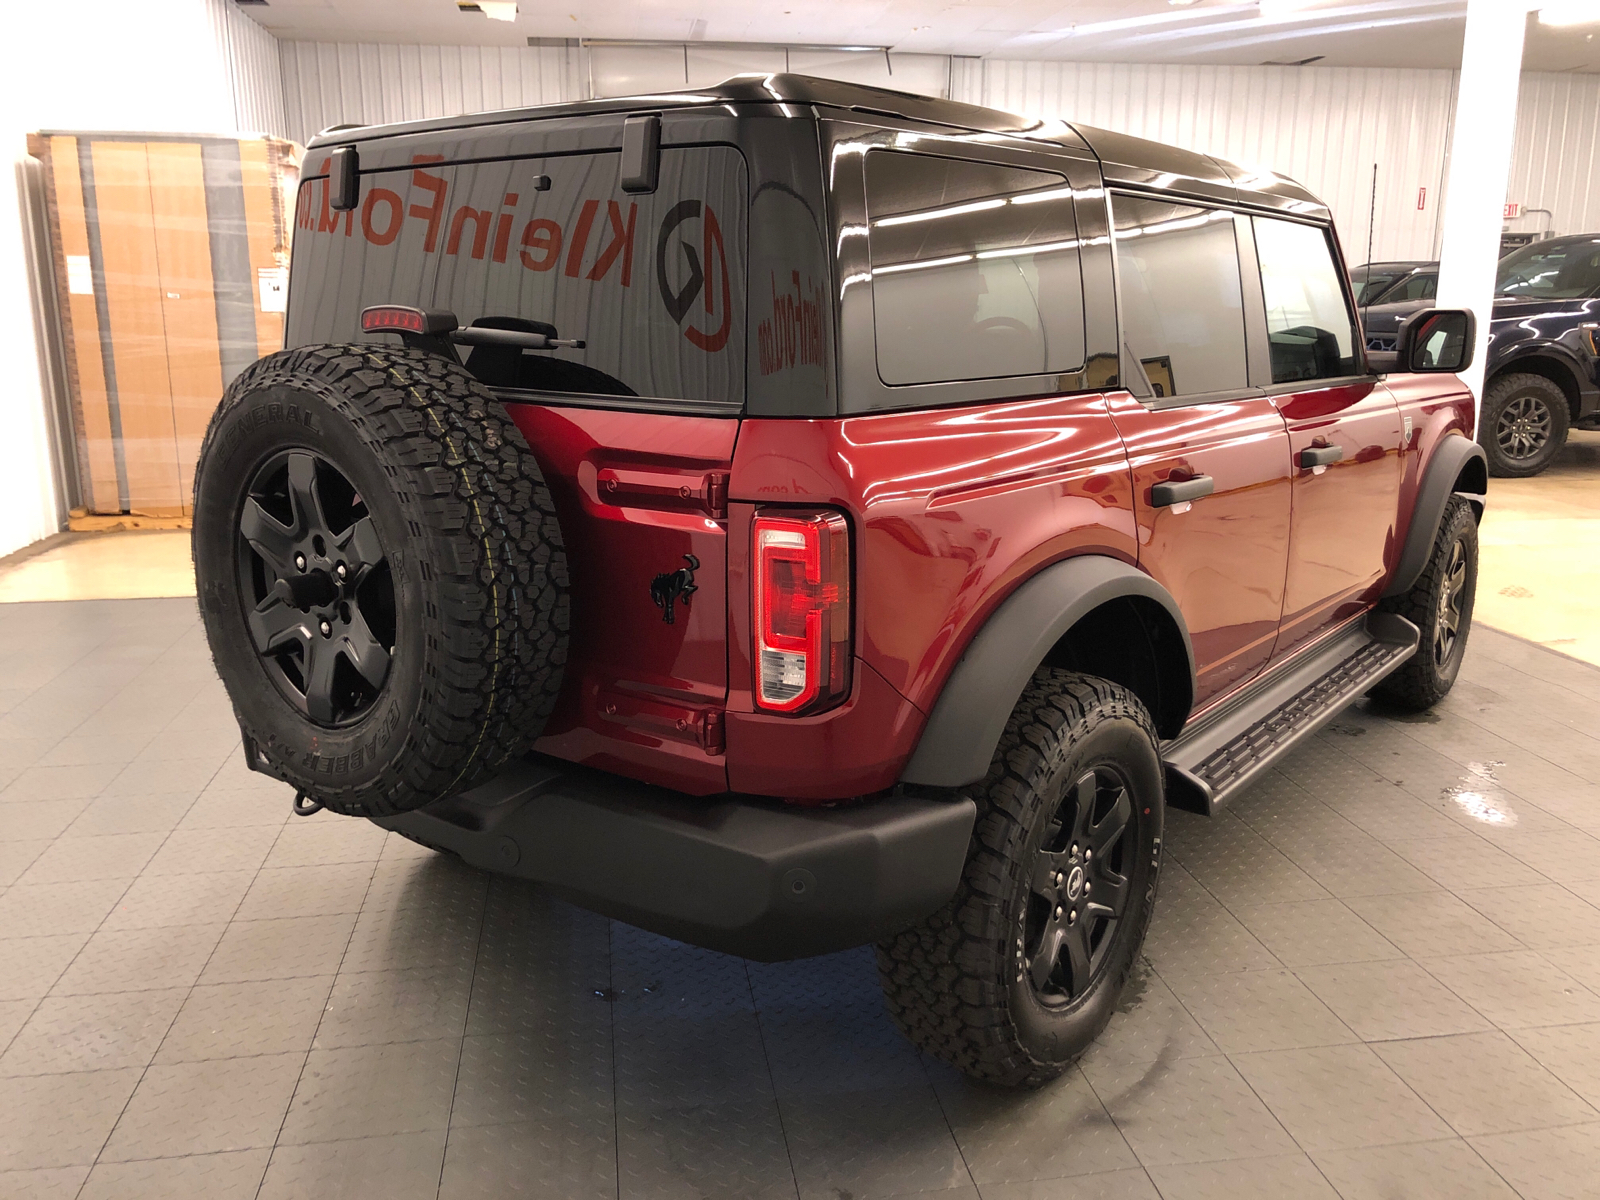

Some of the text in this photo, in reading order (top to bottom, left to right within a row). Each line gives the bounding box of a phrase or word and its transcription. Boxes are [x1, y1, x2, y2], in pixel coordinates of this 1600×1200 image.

[1503, 203, 1519, 217] EXIT
[216, 401, 323, 471] GENERAL
[302, 699, 400, 776] GRABBER
